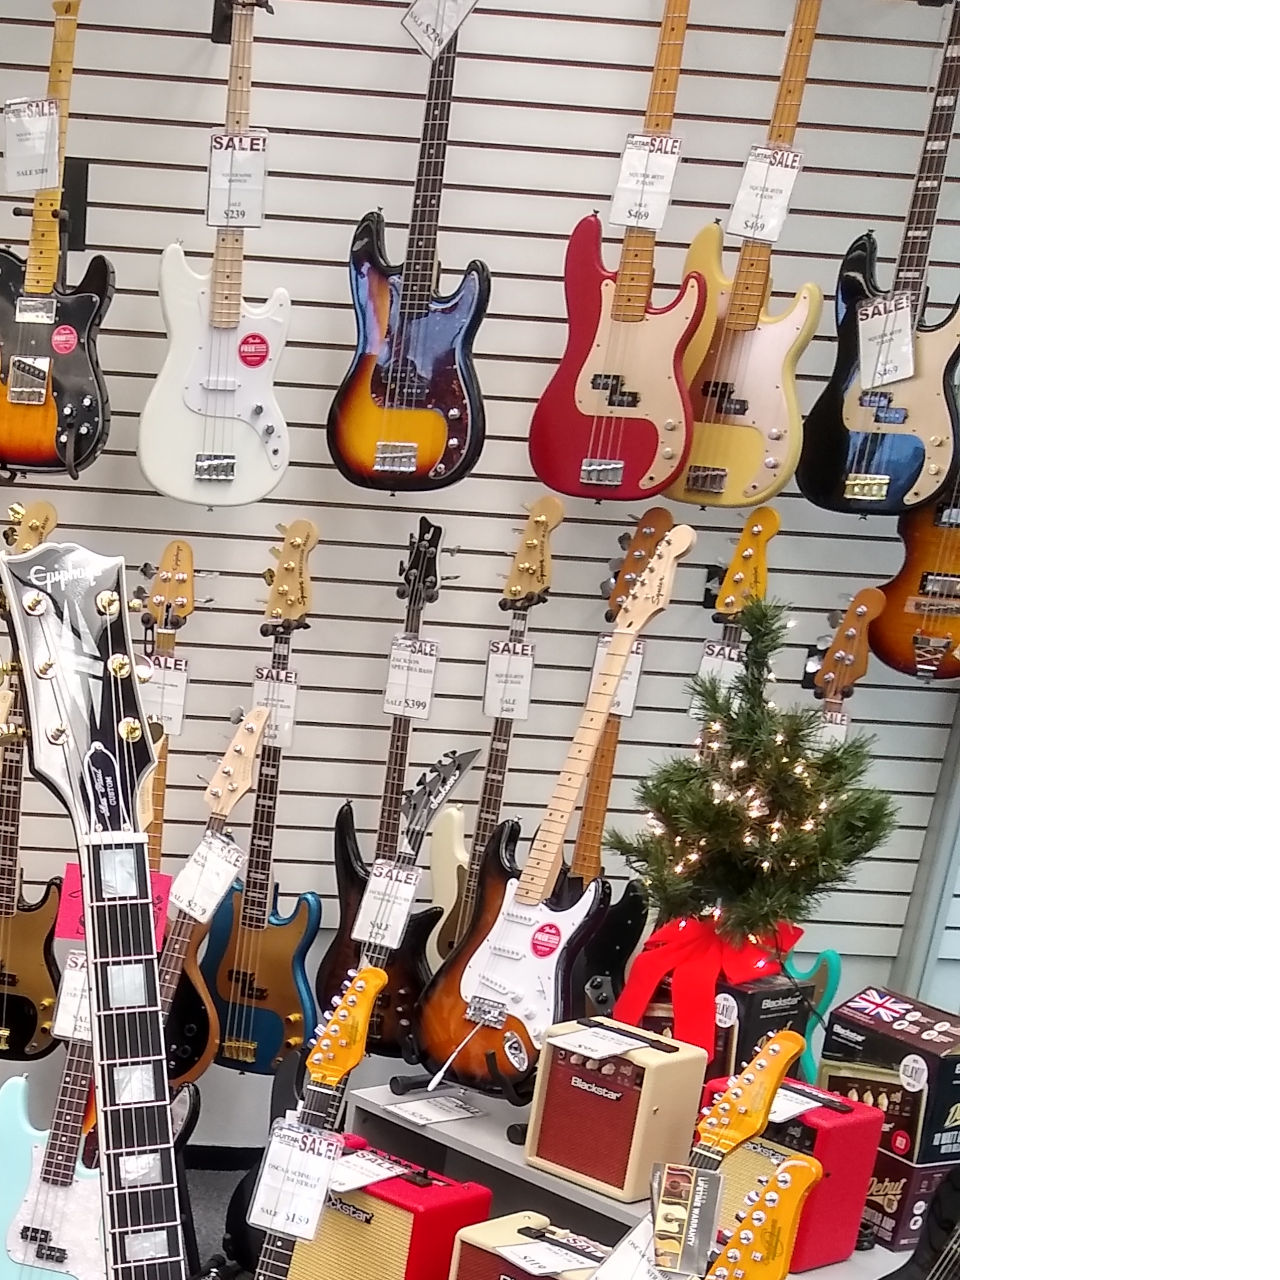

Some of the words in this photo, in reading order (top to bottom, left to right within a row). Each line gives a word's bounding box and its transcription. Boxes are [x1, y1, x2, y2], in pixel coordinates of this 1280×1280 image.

[423, 24, 444, 46] $239
[213, 136, 266, 152] SALE!
[224, 209, 246, 219] $239
[627, 208, 650, 220] $469
[859, 296, 910, 321] SALE!
[651, 575, 665, 605] Squier
[411, 641, 438, 657] SALE!
[491, 642, 535, 656] SALE!
[153, 656, 189, 672] ALE!
[255, 668, 298, 684] SALE!
[404, 698, 427, 710] $399
[104, 776, 117, 806] CUSTOM
[373, 866, 419, 886] SALE!
[570, 1076, 623, 1101] Blackstar
[274, 1132, 300, 1143] GUITAR
[299, 1135, 339, 1160] SALE!
[268, 1163, 289, 1174] OSCAR
[355, 1151, 403, 1176] SALE!
[295, 1178, 317, 1189] STRAT
[692, 1176, 706, 1209] LIFETIME
[261, 1207, 278, 1216] SALE
[327, 1197, 372, 1222] ckstar
[687, 1208, 701, 1247] WARRANTY
